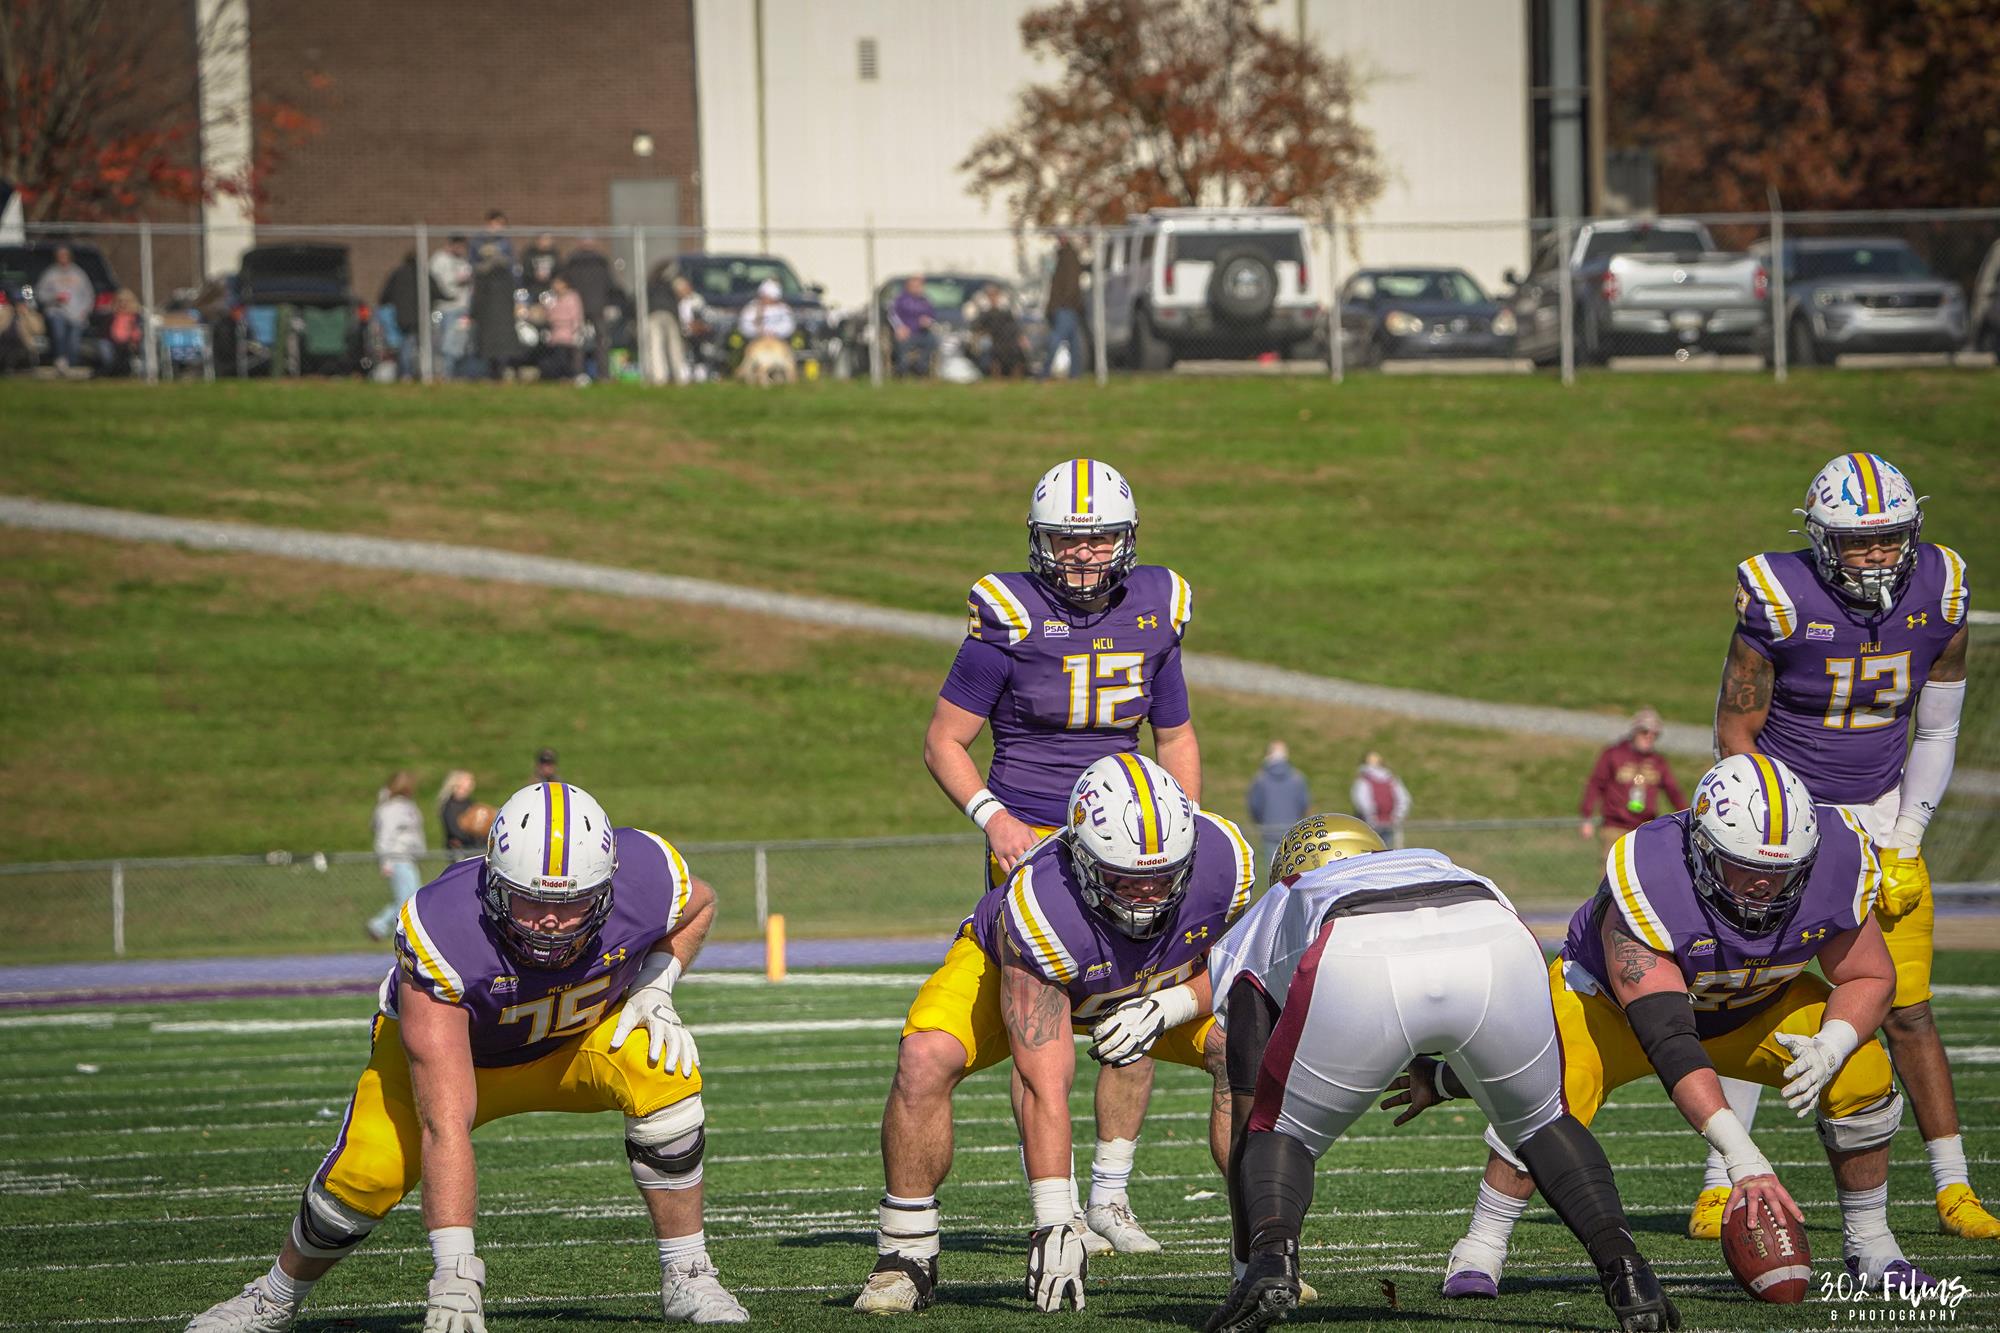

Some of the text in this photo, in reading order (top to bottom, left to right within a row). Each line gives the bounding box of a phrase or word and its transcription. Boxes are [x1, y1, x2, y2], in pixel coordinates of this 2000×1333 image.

[1071, 515, 1094, 523] Riddell
[1045, 625, 1069, 633] PSAC
[1807, 627, 1834, 637] PSAC
[1093, 638, 1114, 650] WCU
[1860, 641, 1882, 654] WCU
[1063, 652, 1145, 729] 12
[1823, 651, 1912, 729] 13
[1701, 772, 1730, 818] WCU
[1137, 856, 1168, 866] Riddell
[541, 879, 568, 888] Riddell
[1743, 958, 1771, 967] WCU
[1135, 963, 1158, 981] WCU
[493, 980, 518, 989] PSAC
[498, 975, 611, 1044] 75
